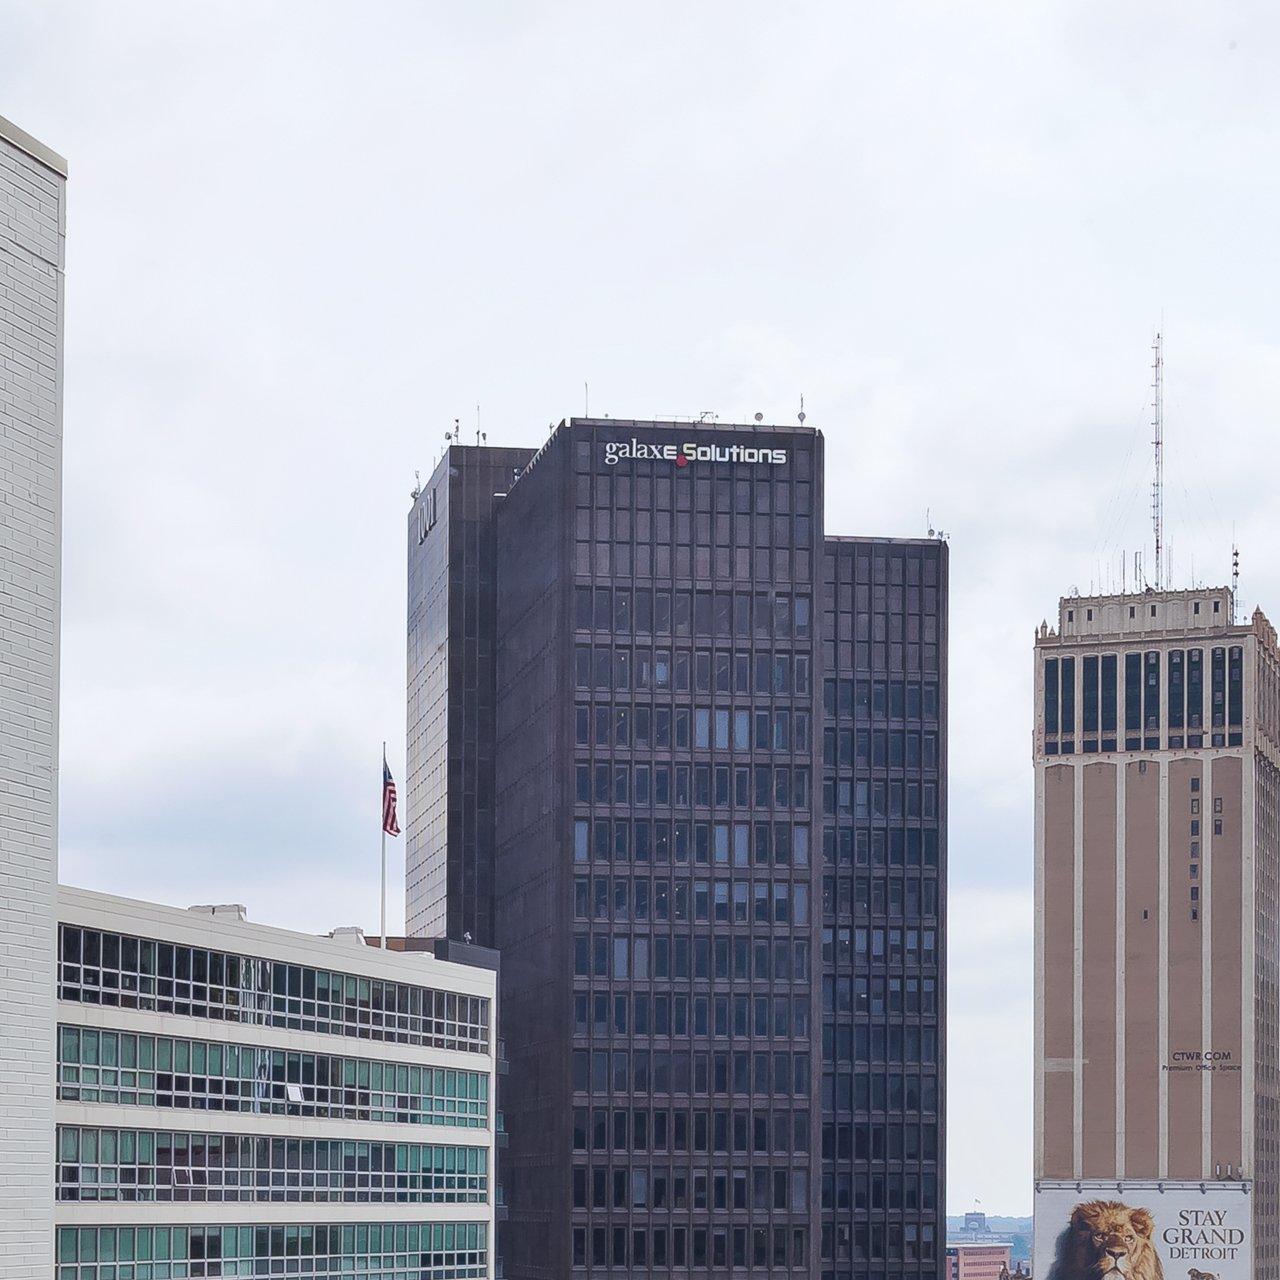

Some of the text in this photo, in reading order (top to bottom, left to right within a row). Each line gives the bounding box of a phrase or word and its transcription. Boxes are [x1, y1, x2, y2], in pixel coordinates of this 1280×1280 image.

[683, 443, 786, 464] Solutions
[1179, 1210, 1227, 1226] STAY
[1163, 1228, 1244, 1245] GRAND
[1170, 1247, 1238, 1259] DETROIT
